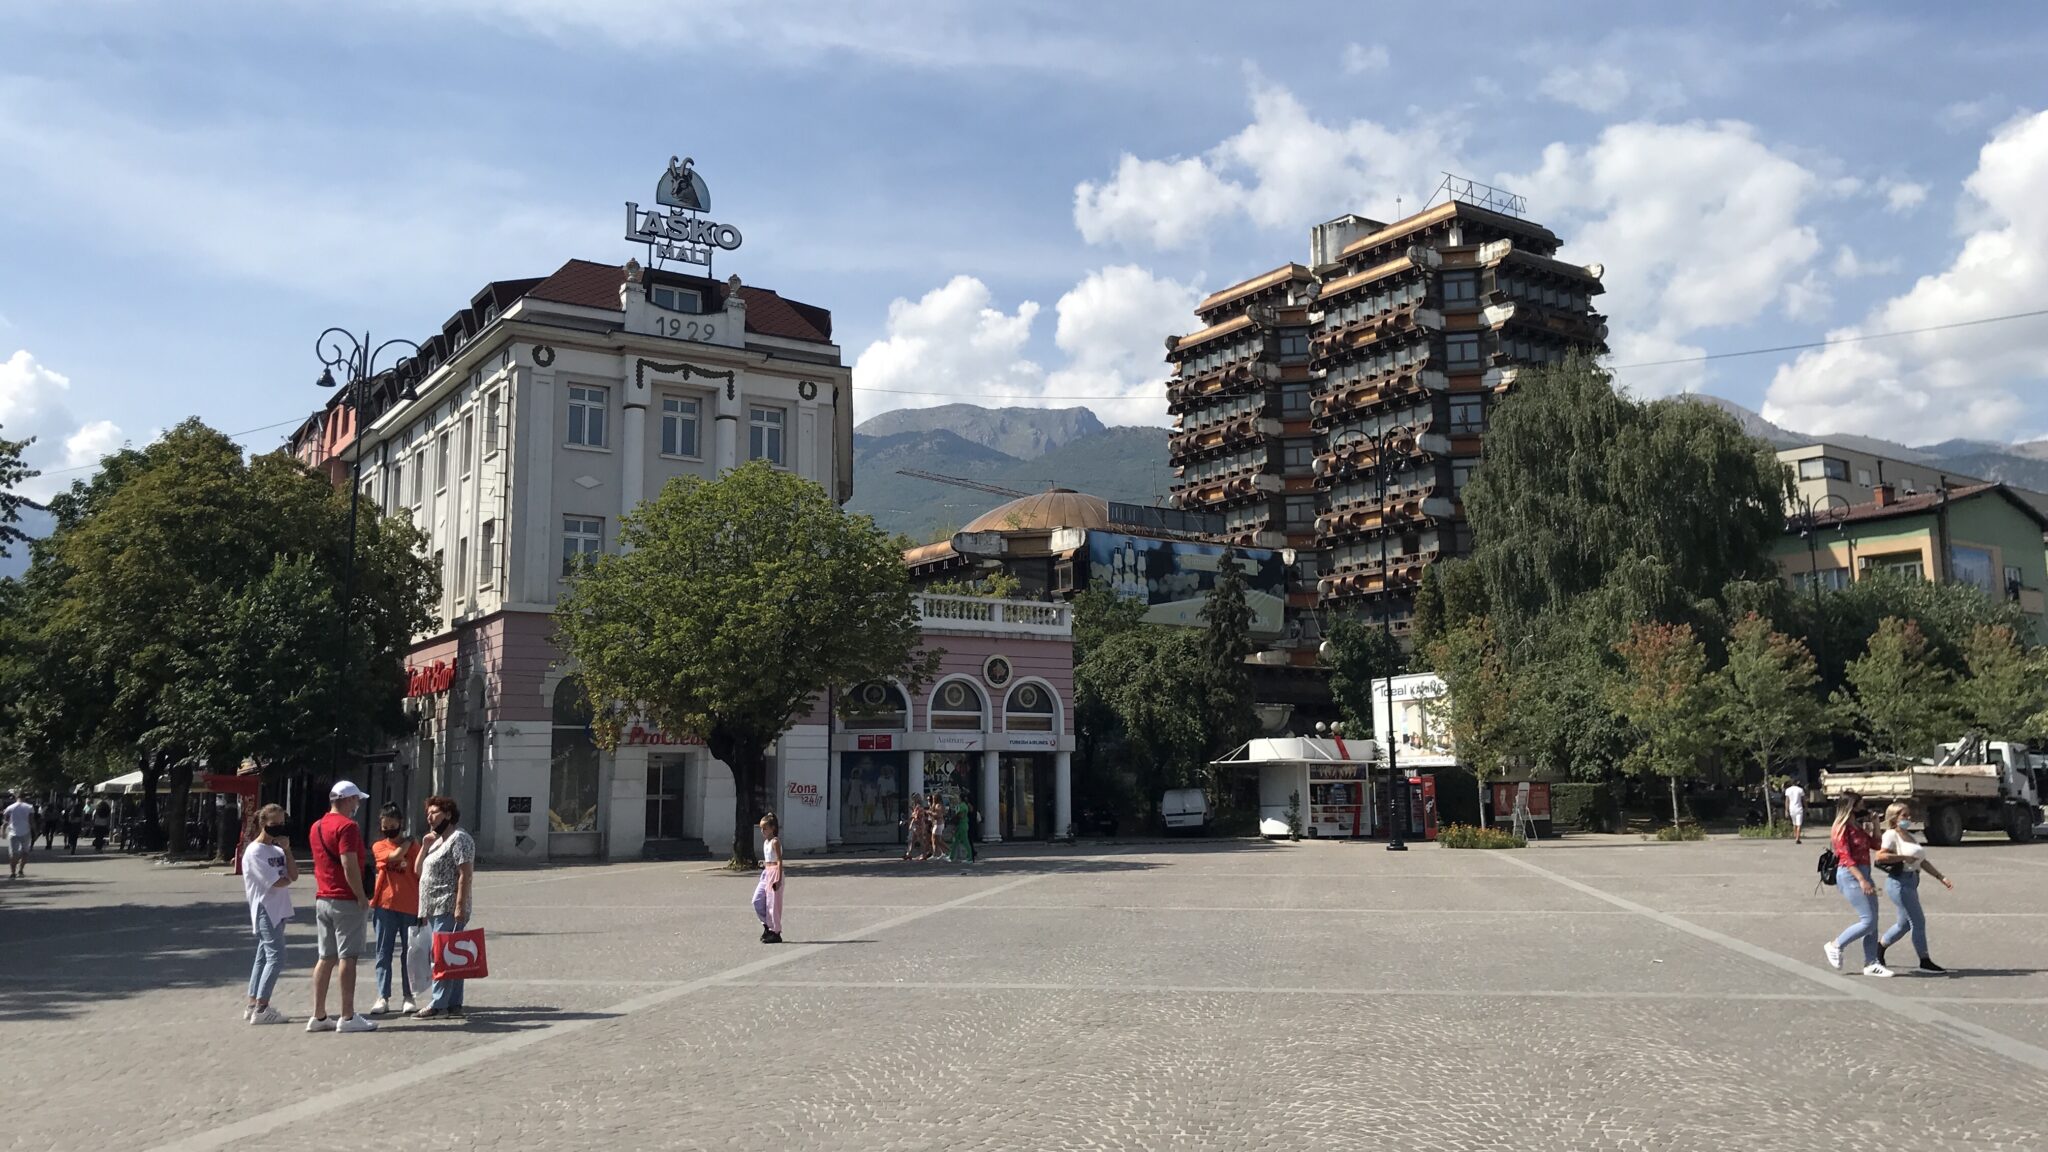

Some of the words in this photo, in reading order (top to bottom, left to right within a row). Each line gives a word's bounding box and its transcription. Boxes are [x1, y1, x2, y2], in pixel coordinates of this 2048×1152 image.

[624, 201, 743, 250] LAŠKO
[656, 241, 713, 266] MALT
[655, 316, 715, 342] 1929
[790, 782, 817, 794] Zona
